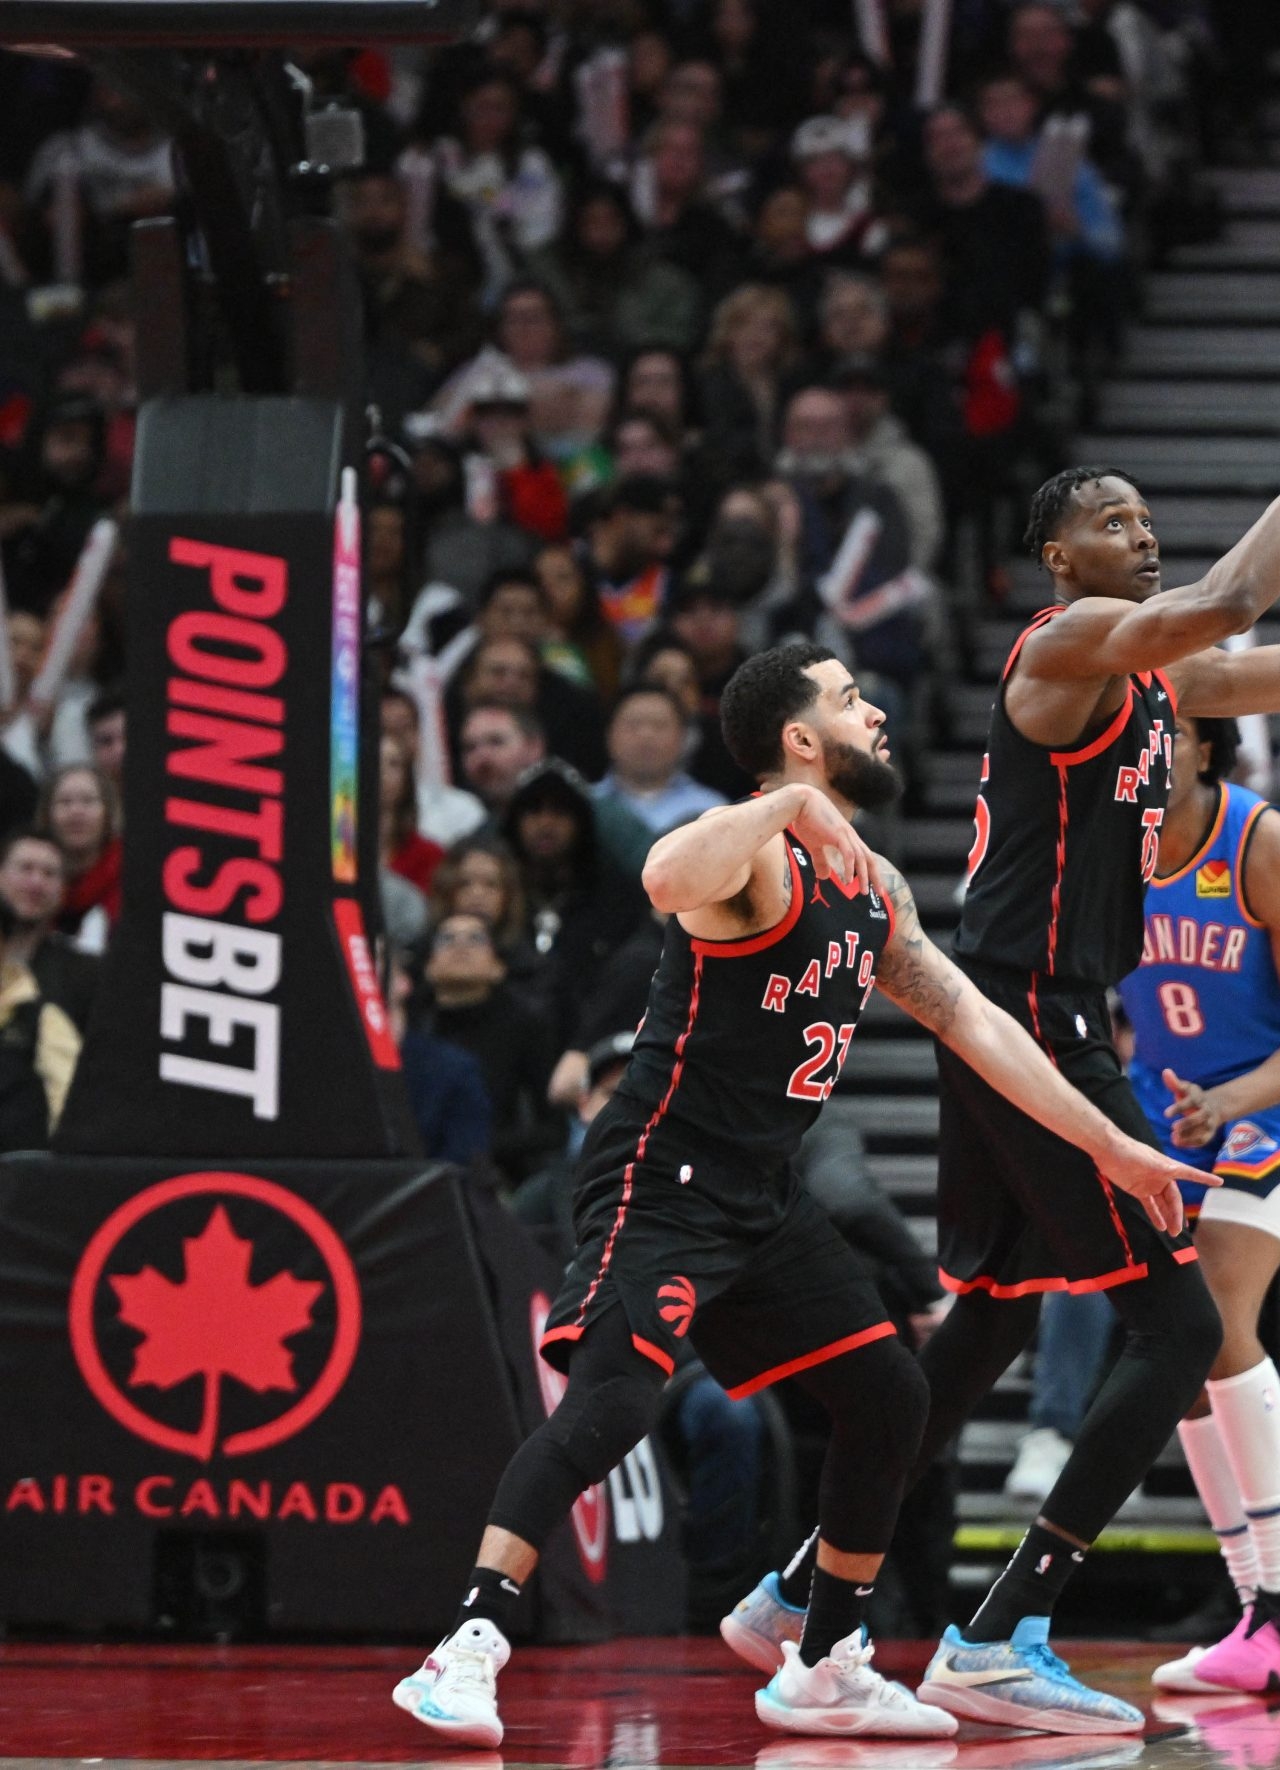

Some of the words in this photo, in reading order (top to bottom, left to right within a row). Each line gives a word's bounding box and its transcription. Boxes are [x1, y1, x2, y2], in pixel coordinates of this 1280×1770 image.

[1114, 719, 1172, 803] RAPTO
[160, 536, 288, 1121] POINTSBET
[791, 847, 808, 867] 6
[1158, 981, 1205, 1037] 8
[6, 1474, 116, 1514] AIR
[134, 1475, 411, 1525] CANADA
